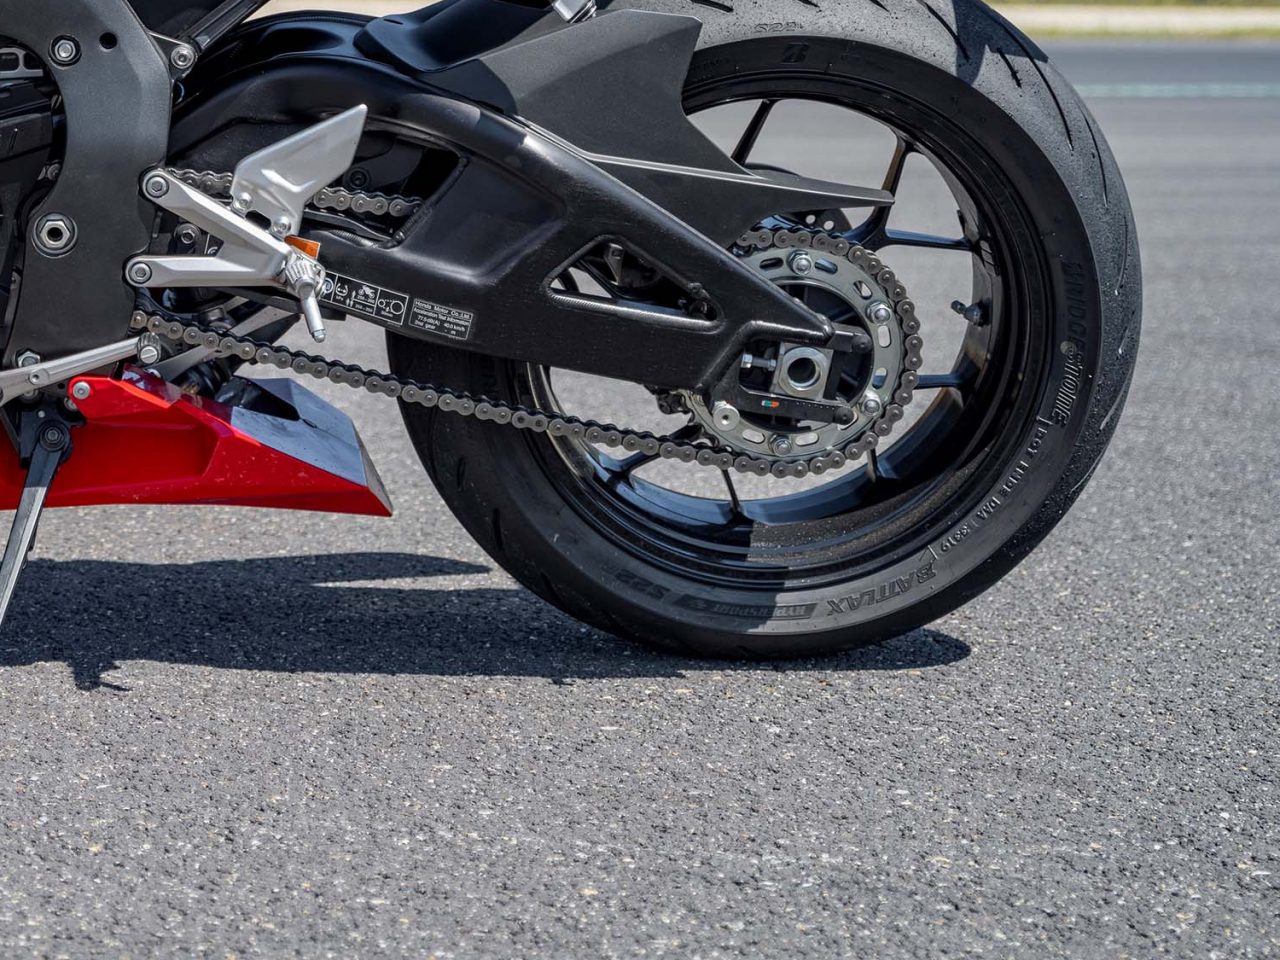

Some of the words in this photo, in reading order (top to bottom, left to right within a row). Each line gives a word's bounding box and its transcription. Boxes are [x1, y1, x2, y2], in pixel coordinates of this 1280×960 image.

[415, 300, 432, 310] Honda
[433, 305, 449, 314] Motor
[826, 562, 937, 618] BATTLAX
